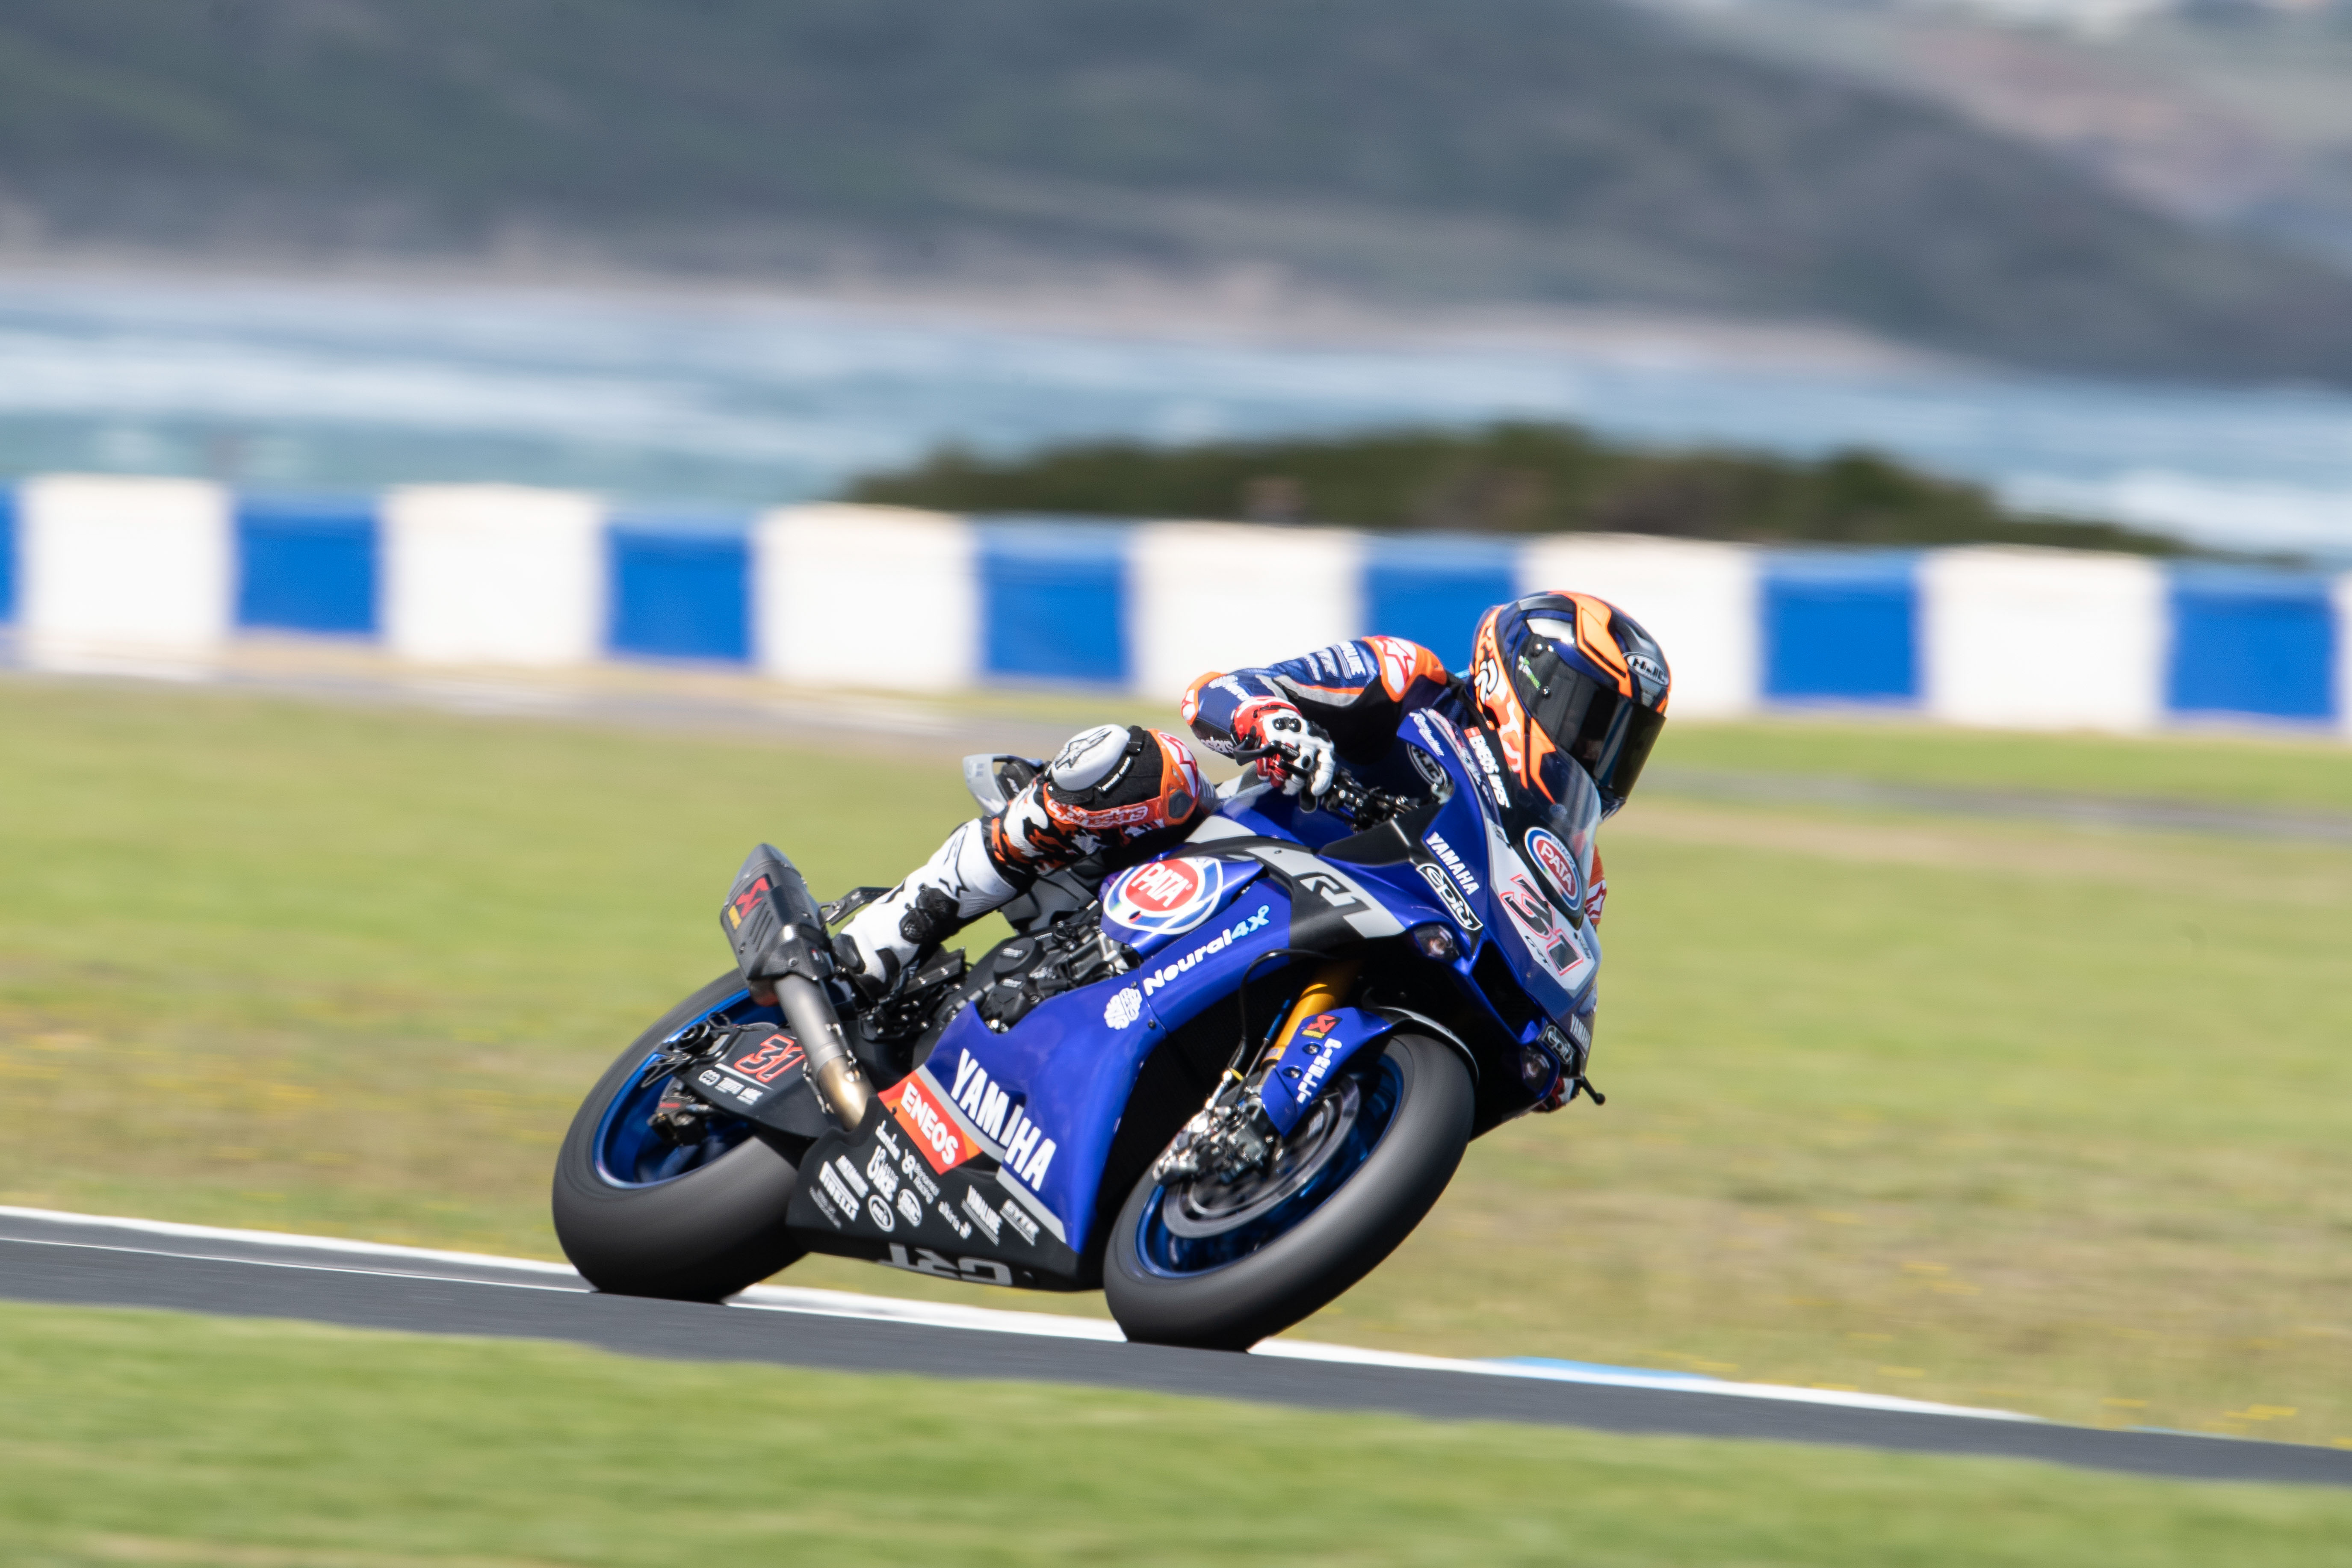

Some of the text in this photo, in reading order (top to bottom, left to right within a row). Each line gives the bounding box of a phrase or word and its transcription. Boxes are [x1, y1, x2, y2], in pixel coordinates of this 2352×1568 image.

[1131, 862, 1187, 908] PATA
[1425, 831, 1480, 895] YAMAHA
[1539, 842, 1572, 893] PATA
[1500, 874, 1584, 976] 31
[734, 1034, 806, 1083] 31
[1297, 1038, 1342, 1104] PIRELLI
[901, 1081, 959, 1165] ENEOS
[819, 1161, 870, 1221] PIRELLI
[877, 1243, 1012, 1285] GRT
